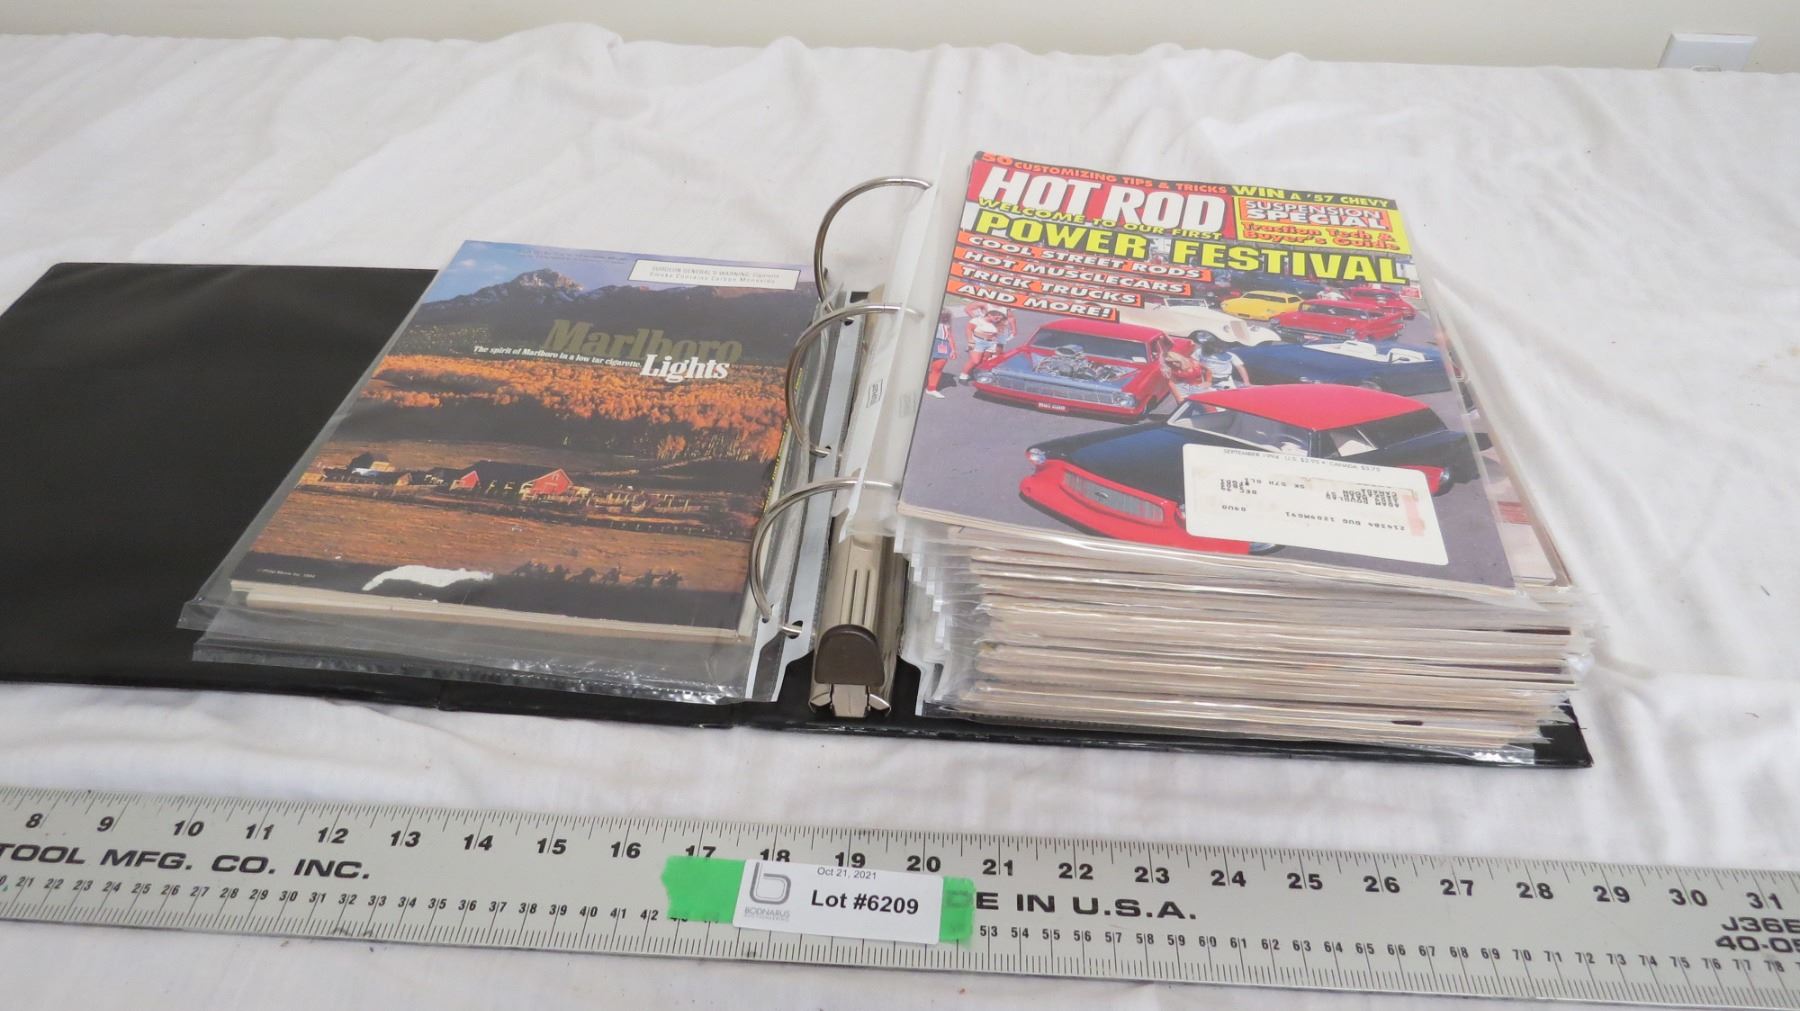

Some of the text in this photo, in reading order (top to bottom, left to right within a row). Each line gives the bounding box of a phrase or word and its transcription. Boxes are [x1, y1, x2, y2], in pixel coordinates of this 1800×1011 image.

[980, 152, 1228, 193] 50 CUSTOMIZING TIPS & TRICKS
[978, 165, 1226, 233] HOT ROD
[1232, 185, 1285, 200] WIN
[1290, 192, 1302, 200] A
[1340, 196, 1389, 208] CHEVY
[1246, 199, 1381, 219] SUSPENSION
[978, 197, 1223, 241] WELCOME TO OUR FIRST
[1241, 221, 1396, 243] Traction Tech &
[1246, 209, 1387, 230] SPECIAL
[968, 235, 1200, 279] COOL STREET RODS
[975, 209, 1410, 285] POWER FESTIVAL
[1243, 230, 1401, 251] Buyer's Guide
[961, 265, 1137, 304] TRICK TRUCKS
[964, 251, 1185, 293] HOT MUSCLECARS
[958, 284, 1111, 318] AND MORE!
[473, 345, 489, 356] The
[489, 347, 512, 357] spirit
[512, 347, 522, 357] of
[522, 348, 558, 360] Marlboro
[559, 352, 568, 360] in
[576, 354, 590, 363] low
[591, 356, 604, 365] tar
[543, 318, 742, 364] Marlboro
[640, 353, 731, 383] Lights
[25, 813, 1783, 910] 8 9 10 11 12 13 14 15 16 17 18 19 20 21 22 23 24 25 26 27 28 29 30 31
[99, 848, 193, 870] MFG.
[211, 854, 276, 875] CO.
[294, 858, 370, 880] INC.
[816, 866, 877, 880] Oct 21, 2021
[16, 876, 34, 888] 21
[44, 878, 64, 890] 22
[72, 879, 93, 891] 23
[102, 881, 122, 893] 24
[131, 883, 152, 894] 25
[160, 884, 181, 896] 26
[190, 886, 210, 897] 27
[219, 887, 239, 899] 28
[249, 889, 269, 900] 29
[279, 890, 298, 902] 30
[308, 891, 327, 903] 31
[338, 893, 357, 905] 32
[368, 895, 387, 907] 33
[398, 896, 417, 908] 34
[427, 898, 447, 910] 35
[458, 899, 477, 911] 36
[488, 901, 507, 912] 37
[518, 902, 538, 914] 38
[549, 904, 568, 916] 39
[579, 905, 598, 917] 40
[610, 907, 627, 919] 41
[640, 909, 659, 921] 42
[811, 889, 919, 915] Lot #6209
[1016, 893, 1056, 914] IN
[1072, 896, 1197, 920] U.S.A.
[979, 925, 998, 937] 53
[1011, 926, 1029, 938] 54
[1042, 928, 1060, 940] 55
[1073, 929, 1092, 942] 56
[1104, 931, 1122, 943] 57
[1136, 932, 1154, 945] 58
[1167, 934, 1185, 946] 59
[1198, 935, 1217, 948] 60
[1230, 936, 1247, 949] 61
[1261, 938, 1280, 950] 62
[1292, 940, 1311, 952] 63
[1323, 941, 1343, 953] 64
[1355, 942, 1375, 955] 65
[1386, 943, 1406, 956] 66
[1418, 945, 1436, 957] 67
[1449, 946, 1469, 959] 68
[1480, 947, 1500, 960] 69
[1512, 948, 1532, 961] 70
[1545, 951, 1563, 962] 71
[1575, 952, 1595, 964] 72
[1606, 953, 1627, 965] 73
[1638, 954, 1658, 967] 74
[1670, 956, 1690, 968] 75
[1701, 957, 1722, 970] 76
[1732, 958, 1752, 971] 77
[1763, 960, 1785, 972] 78
